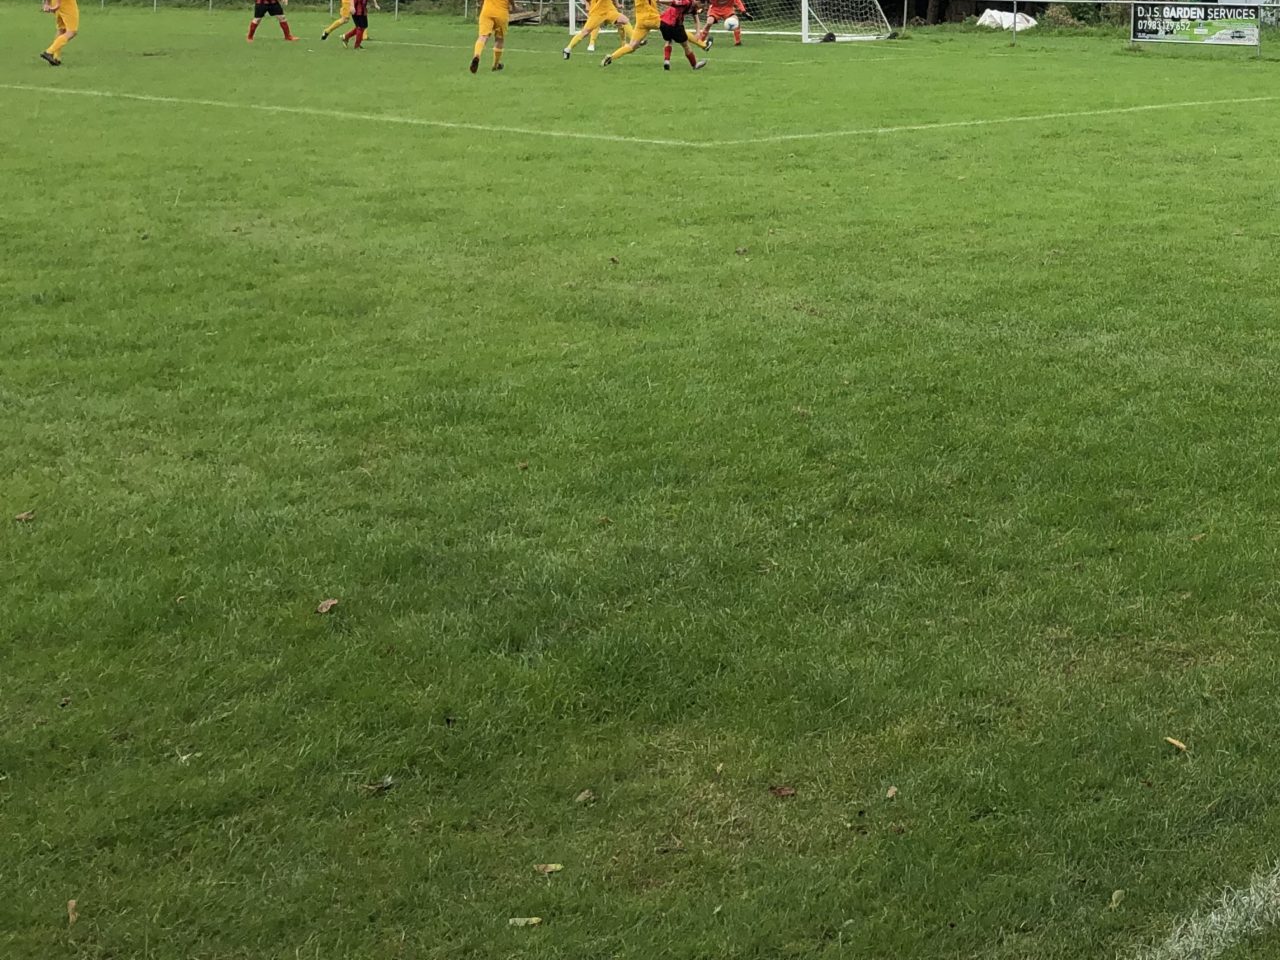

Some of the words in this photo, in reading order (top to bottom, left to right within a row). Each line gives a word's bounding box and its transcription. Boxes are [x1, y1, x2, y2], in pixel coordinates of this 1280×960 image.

[1137, 6, 1161, 18] D.J.S.
[1163, 7, 1205, 19] GARDEN
[1207, 8, 1256, 20] SERVICES
